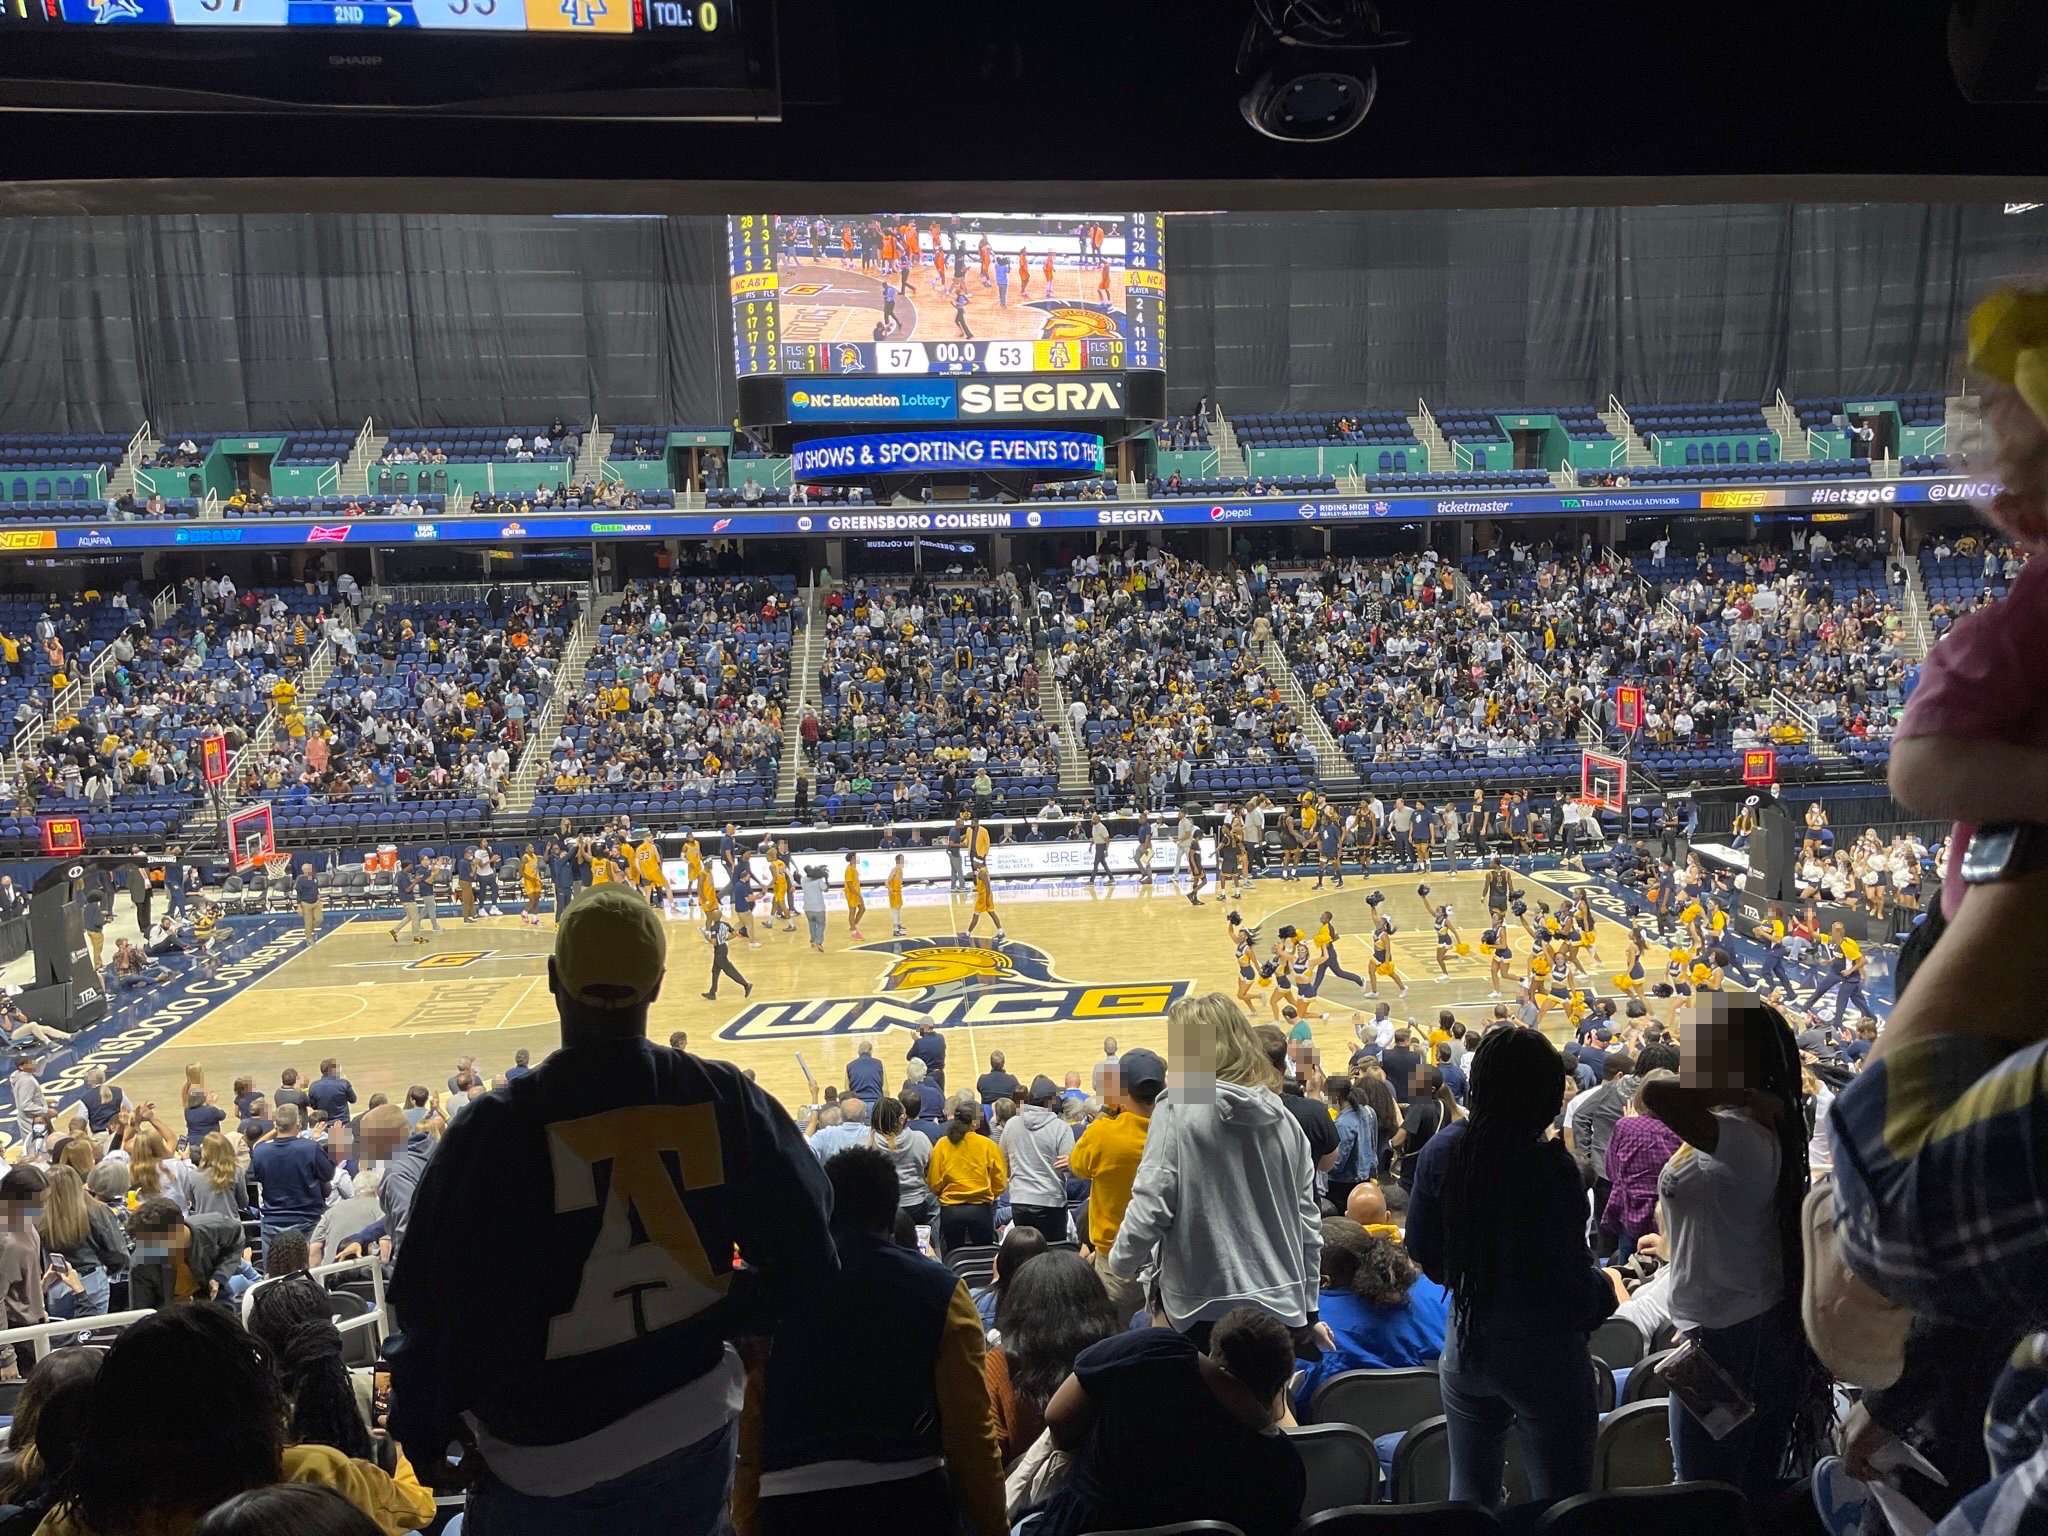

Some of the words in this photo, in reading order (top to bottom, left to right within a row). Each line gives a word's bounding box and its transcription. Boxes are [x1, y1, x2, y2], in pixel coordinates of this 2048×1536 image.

[334, 7, 364, 25] 2ND
[654, 2, 693, 26] TOL:
[699, 2, 718, 32] 0
[329, 56, 382, 65] SHARP
[741, 215, 753, 229] 28
[1132, 213, 1145, 225] 10
[744, 231, 751, 242] 2
[762, 229, 770, 241] 3
[1132, 227, 1145, 239] 12
[744, 245, 752, 257] 4
[1132, 242, 1145, 253] 24
[745, 260, 752, 272] 3
[763, 258, 771, 270] 2
[1132, 256, 1145, 267] 44
[735, 279, 746, 290] NC
[747, 277, 769, 288] A&T
[1128, 287, 1149, 295] PLAYER
[747, 303, 755, 315] 6
[765, 301, 773, 313] 4
[1136, 298, 1144, 310] 2
[747, 317, 758, 328] 17
[766, 315, 774, 327] 3
[1136, 312, 1144, 323] 4
[747, 331, 759, 343] 17
[767, 330, 775, 342] 0
[1134, 326, 1146, 338] 11
[750, 346, 757, 357] 7
[768, 345, 776, 356] 3
[786, 346, 805, 356] FLS:
[808, 345, 816, 357] 9
[936, 343, 976, 361] 00.0
[1090, 342, 1108, 352] FLS:
[1108, 340, 1123, 354] 10
[1134, 340, 1147, 352] 12
[890, 350, 913, 368] 57
[1000, 348, 1022, 366] 53
[1090, 356, 1108, 366] TOL:
[1111, 355, 1120, 368] 0
[1135, 354, 1148, 366] 13
[751, 360, 758, 372] 3
[768, 359, 777, 371] 2
[787, 360, 806, 370] TOL:
[808, 359, 815, 372] 1
[949, 363, 963, 371] 2ND
[811, 394, 832, 406] NC
[832, 393, 900, 407] Education
[901, 394, 950, 409] Lottery
[961, 382, 1121, 414] SEGRA
[805, 445, 855, 469] SHOWS
[860, 444, 875, 464] &
[879, 440, 985, 464] SPORTING
[990, 440, 1058, 460] EVENTS
[1061, 441, 1080, 461] TO
[1081, 442, 1098, 462] THE
[1712, 490, 1767, 508] UNCG
[1811, 485, 1896, 505] #letsgoG
[1319, 504, 1348, 512] RIDING
[1349, 503, 1370, 511] HIGH
[1437, 500, 1511, 514] ticketmaster
[1560, 499, 1581, 508] TFA
[1581, 499, 1604, 507] TRIAD
[1605, 498, 1642, 506] FINANCIAL
[1644, 497, 1680, 505] ADVISORS
[1098, 509, 1164, 524] SEGRA
[1225, 507, 1253, 519] pepsi
[828, 514, 931, 530] GREENSBORO
[934, 512, 1011, 528] COLISEUM
[0, 532, 43, 548] NCG
[190, 529, 244, 543] BRADY
[414, 530, 437, 538] LIGHT
[147, 855, 177, 864] SPALDING
[640, 851, 650, 860] 33
[1042, 850, 1080, 864] JBRE
[1743, 904, 1760, 920] TFA
[185, 927, 322, 994] Coliseum
[79, 986, 98, 1004] TFA
[710, 979, 1198, 1042] UNCG
